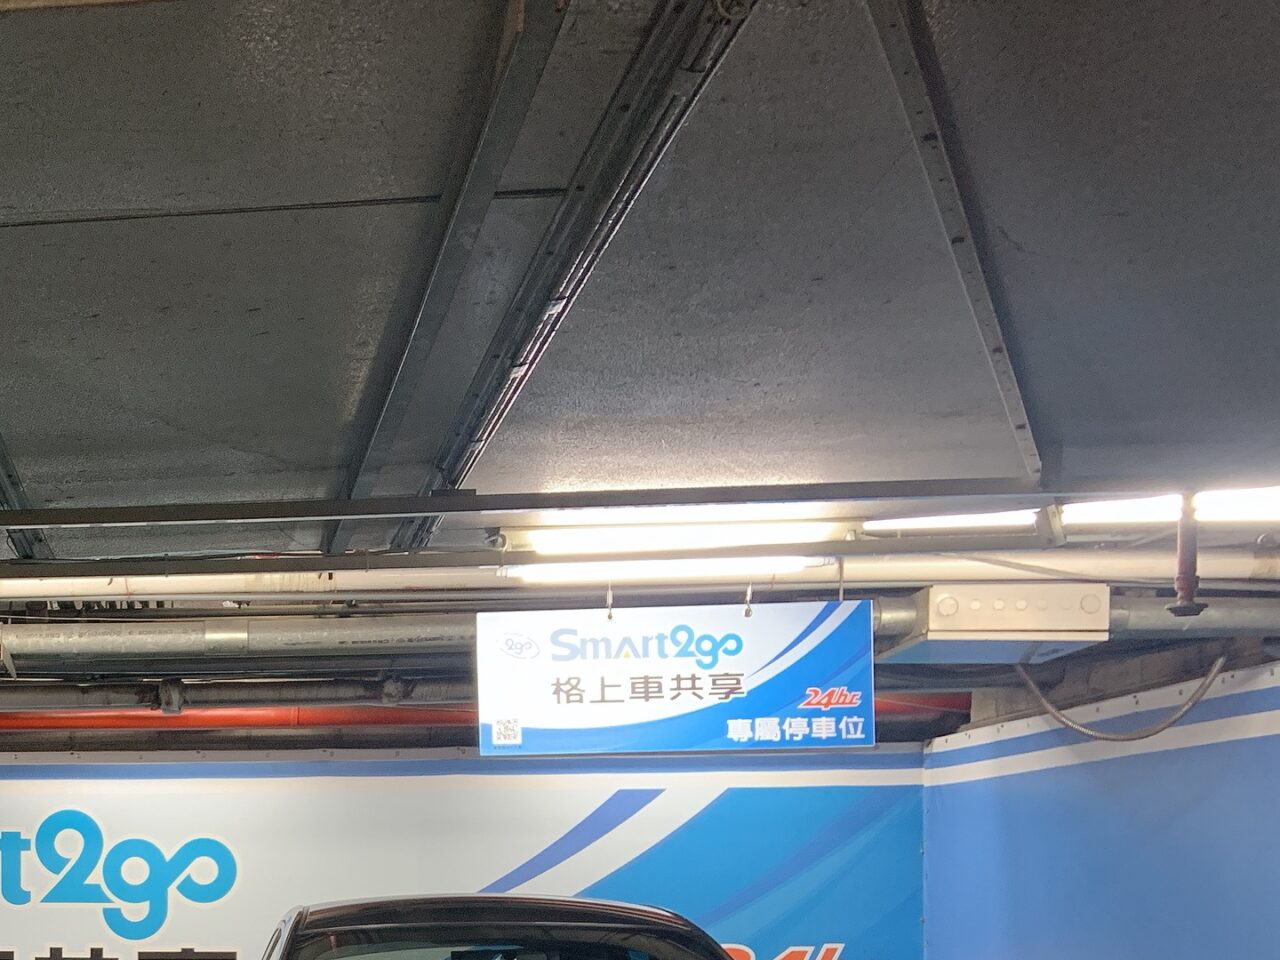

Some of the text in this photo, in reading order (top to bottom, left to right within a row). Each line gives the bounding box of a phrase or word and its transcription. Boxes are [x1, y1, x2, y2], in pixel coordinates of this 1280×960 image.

[551, 672, 745, 704] 格上車共享
[798, 686, 863, 711] 24hr
[726, 716, 866, 742] 專屬停車位
